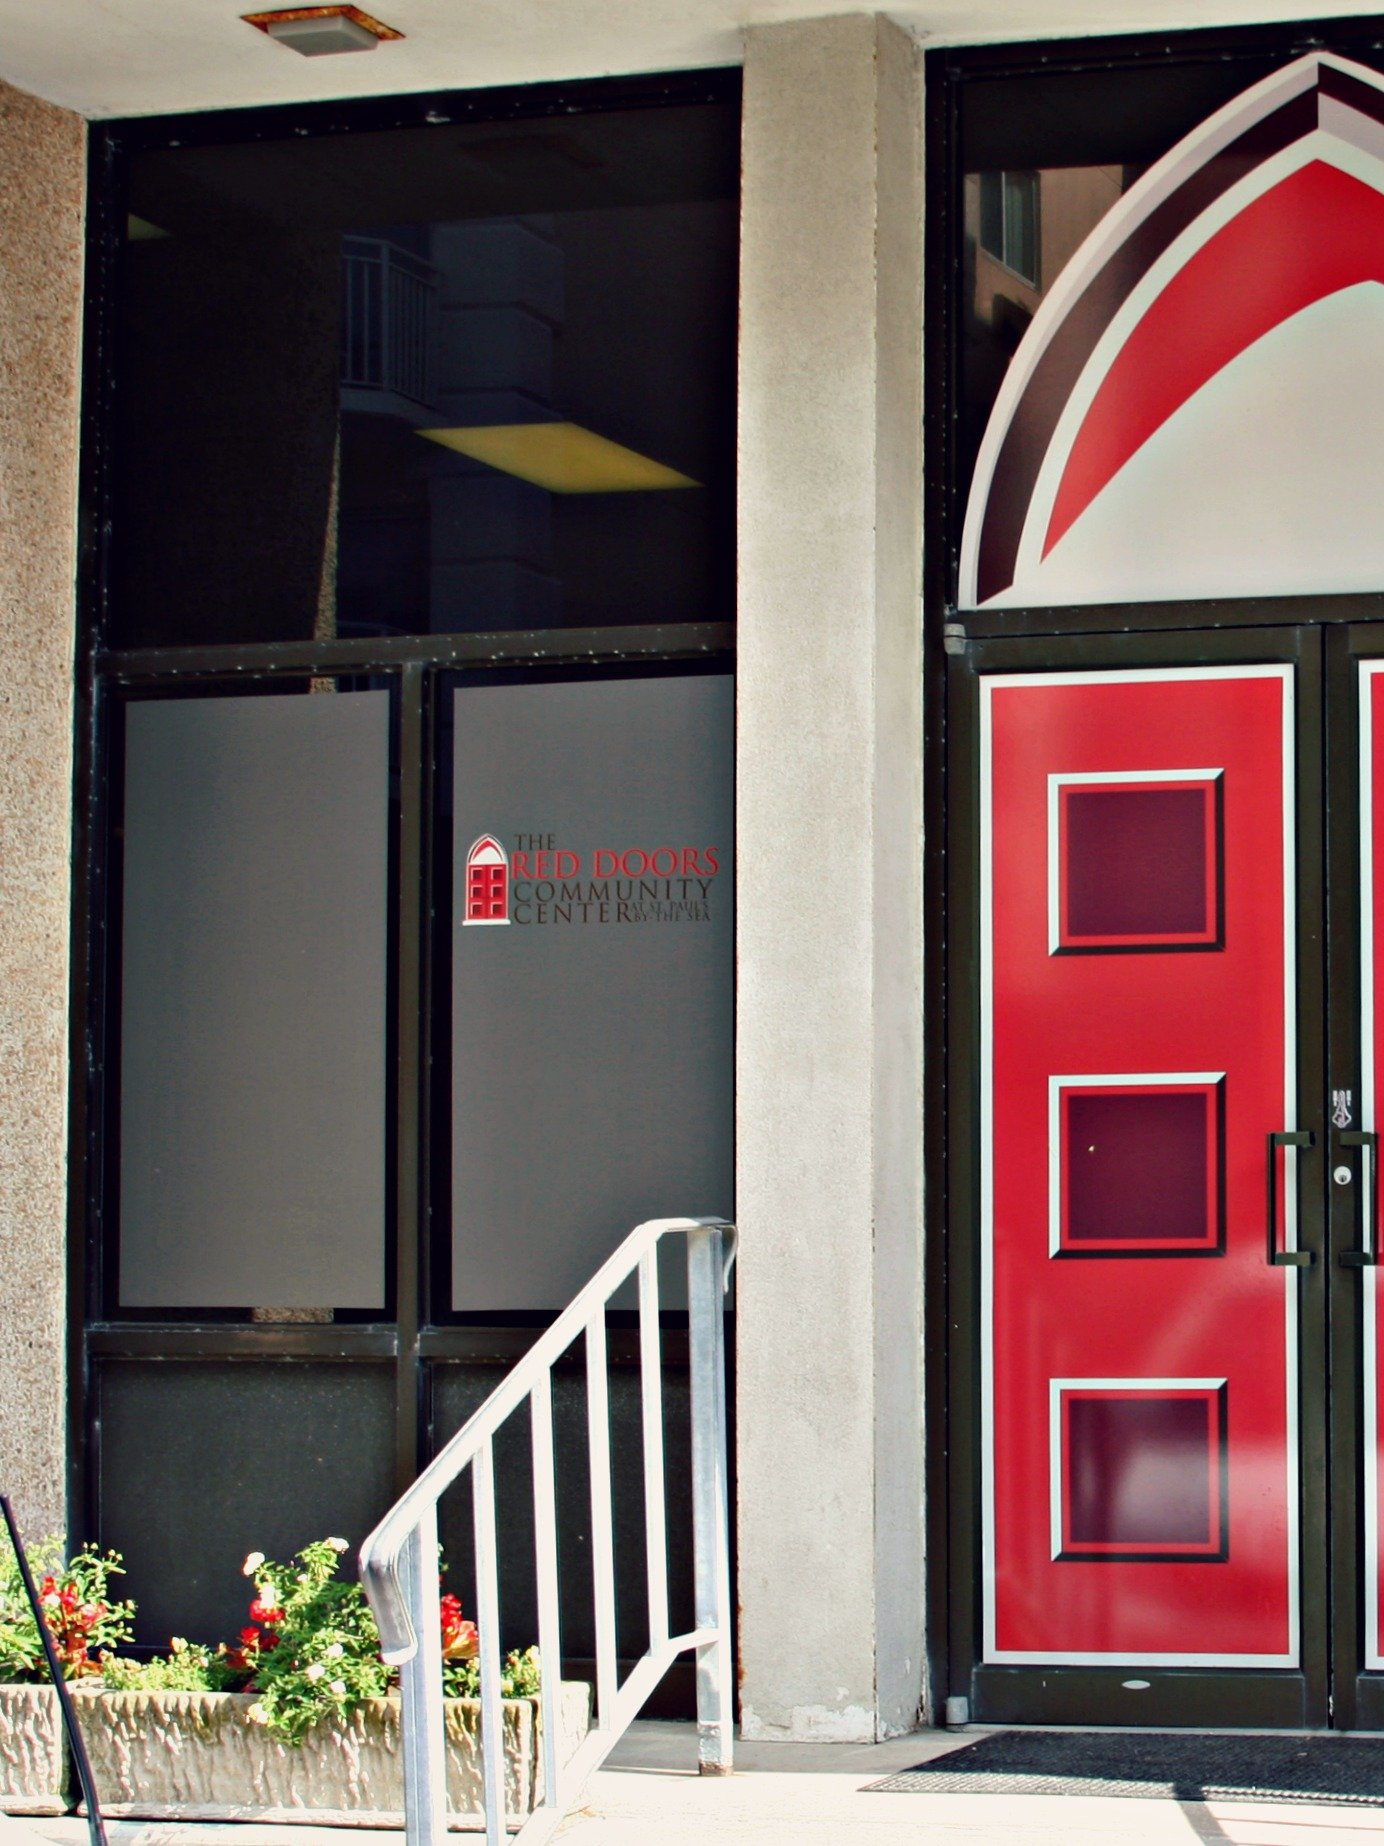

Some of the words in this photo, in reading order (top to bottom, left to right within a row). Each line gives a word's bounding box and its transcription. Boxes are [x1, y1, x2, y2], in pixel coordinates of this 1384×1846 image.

[514, 833, 556, 850] THE
[511, 849, 580, 880] RED
[593, 846, 720, 879] DOORS
[513, 878, 714, 902] COMMUNITY
[513, 902, 635, 925] CENTER
